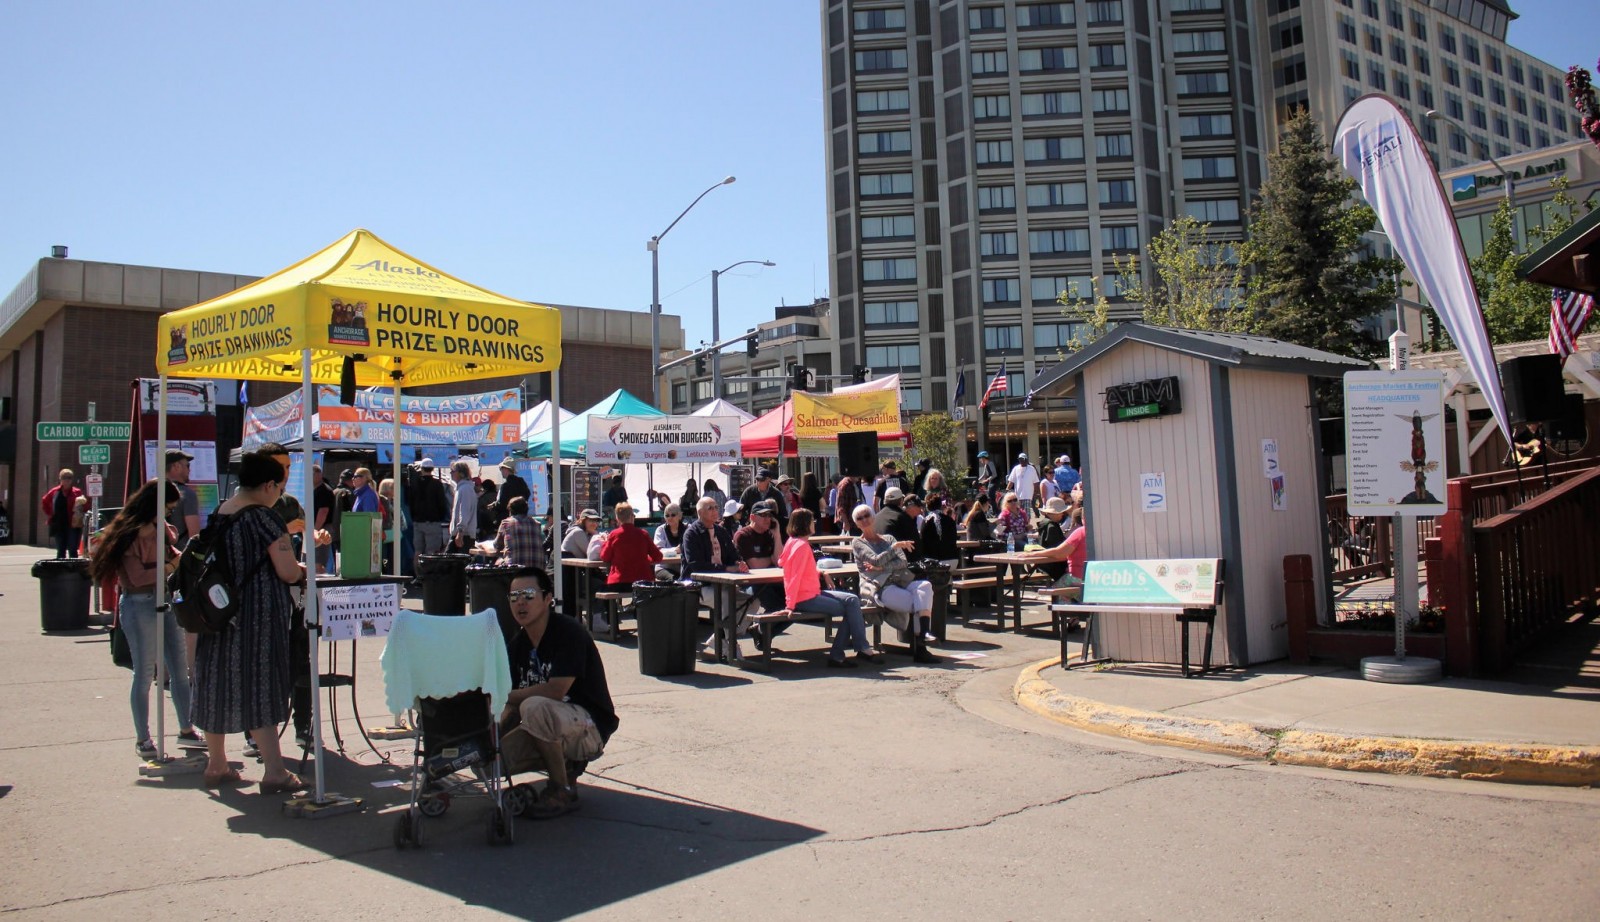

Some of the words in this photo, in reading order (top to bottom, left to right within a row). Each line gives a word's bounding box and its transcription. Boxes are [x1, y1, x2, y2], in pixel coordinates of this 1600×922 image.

[1477, 171, 1521, 188] Doyn
[1524, 158, 1566, 178] Anvil
[350, 260, 440, 279] Alaska
[192, 311, 237, 338] HOURLY
[240, 304, 275, 328] DOOR
[378, 302, 460, 332] HOURLY
[467, 313, 519, 338] DOOR
[190, 339, 224, 361] PRIZE
[225, 326, 293, 355] DRAWINGS
[376, 329, 438, 352] PRIZE
[443, 335, 545, 363] DRAWINGS
[1104, 378, 1173, 408] ATM
[1349, 383, 1381, 391] Anchorage
[1414, 382, 1439, 390] Festival
[353, 392, 394, 410] ILD
[407, 394, 504, 411] ALASKA
[1368, 394, 1420, 402] HEADQUARTERS
[356, 408, 394, 422] TACO
[406, 412, 416, 424] &
[421, 411, 489, 425] BURRITOS
[1126, 406, 1150, 416] INSIDE
[673, 423, 682, 431] EPIC
[797, 414, 839, 428] Salmon
[842, 412, 898, 429] Quesadillas
[44, 426, 83, 437] CARIBOU
[91, 426, 130, 437] CORRIDO
[368, 427, 412, 440] BREAKST
[452, 428, 484, 442] BURRITO
[619, 432, 648, 444] SMOKED
[650, 432, 679, 444] SALMON
[680, 432, 713, 444] BURGERS
[687, 450, 709, 458] Lettuce
[710, 450, 728, 459] Wraps
[1263, 443, 1277, 453] ATM
[595, 451, 615, 459] Sliders
[644, 452, 666, 460] Burgers
[1143, 478, 1163, 488] ATM
[1089, 567, 1148, 586] Webb's
[329, 613, 351, 621] PRIZE
[354, 611, 393, 619] DRAWINGS
